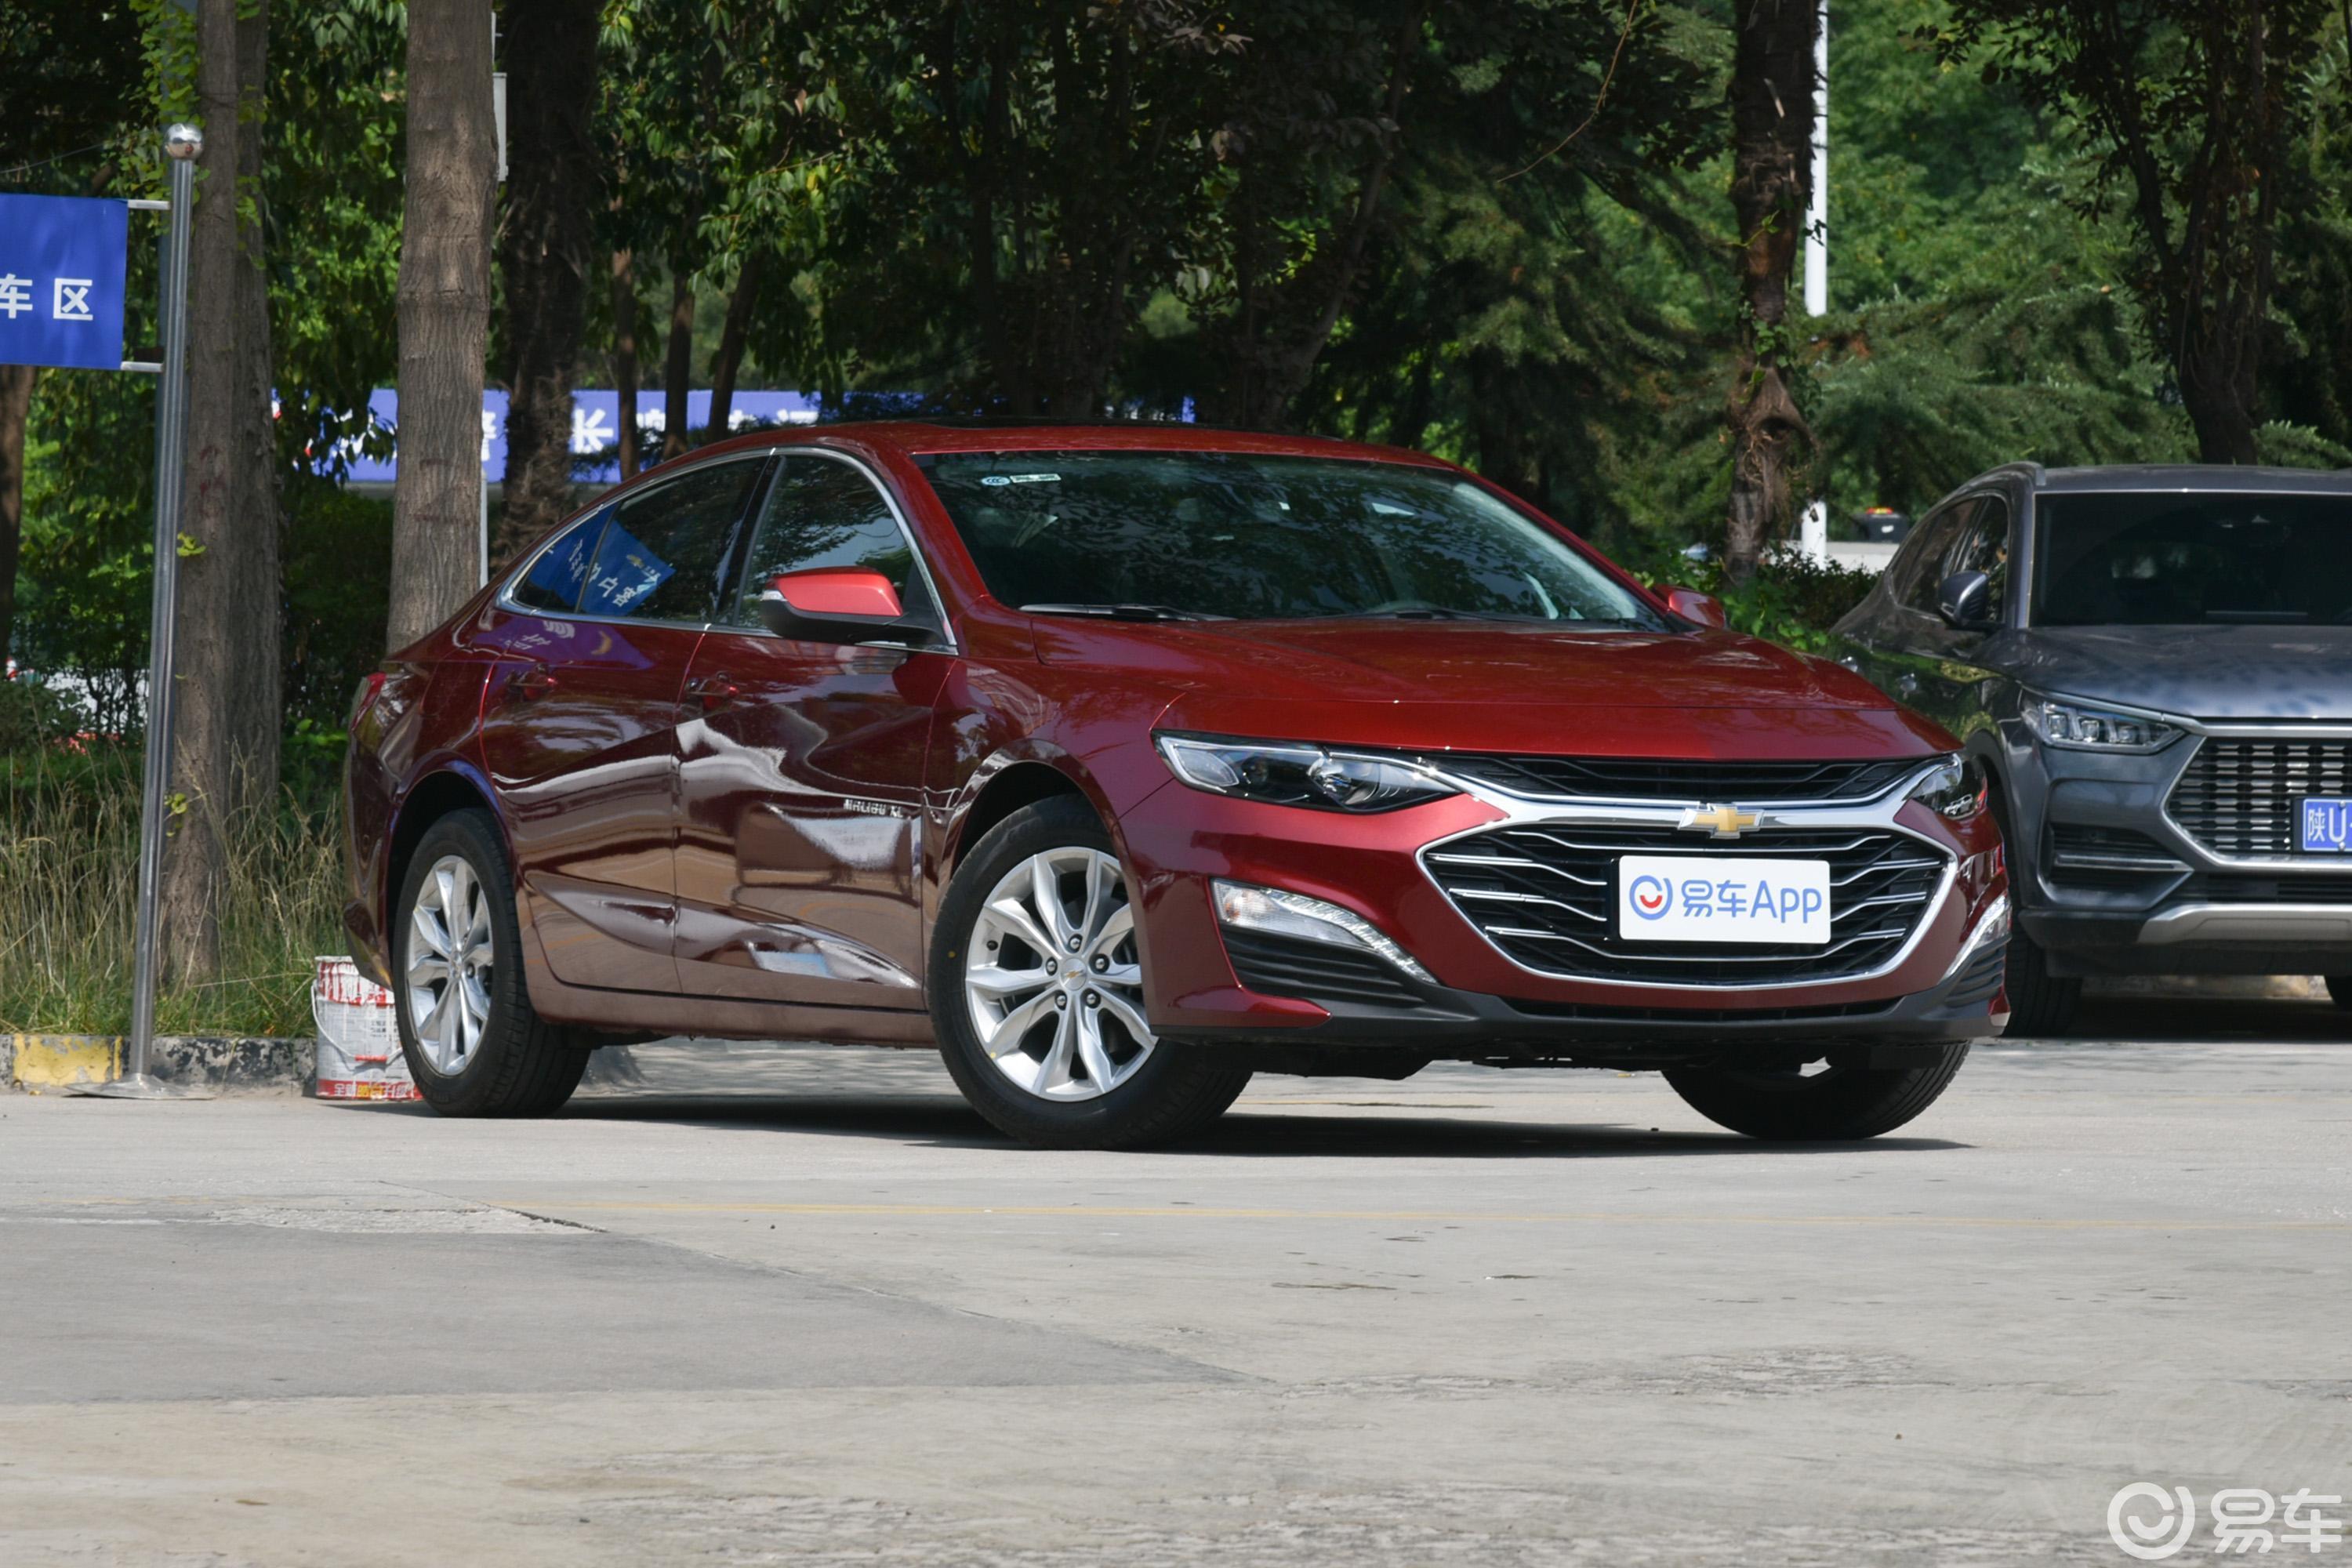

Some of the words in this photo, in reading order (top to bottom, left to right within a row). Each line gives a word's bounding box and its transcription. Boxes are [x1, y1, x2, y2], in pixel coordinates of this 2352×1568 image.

[0, 273, 93, 321] 车区
[844, 799, 887, 815] MALIBU
[1681, 879, 1822, 924] 易车App
